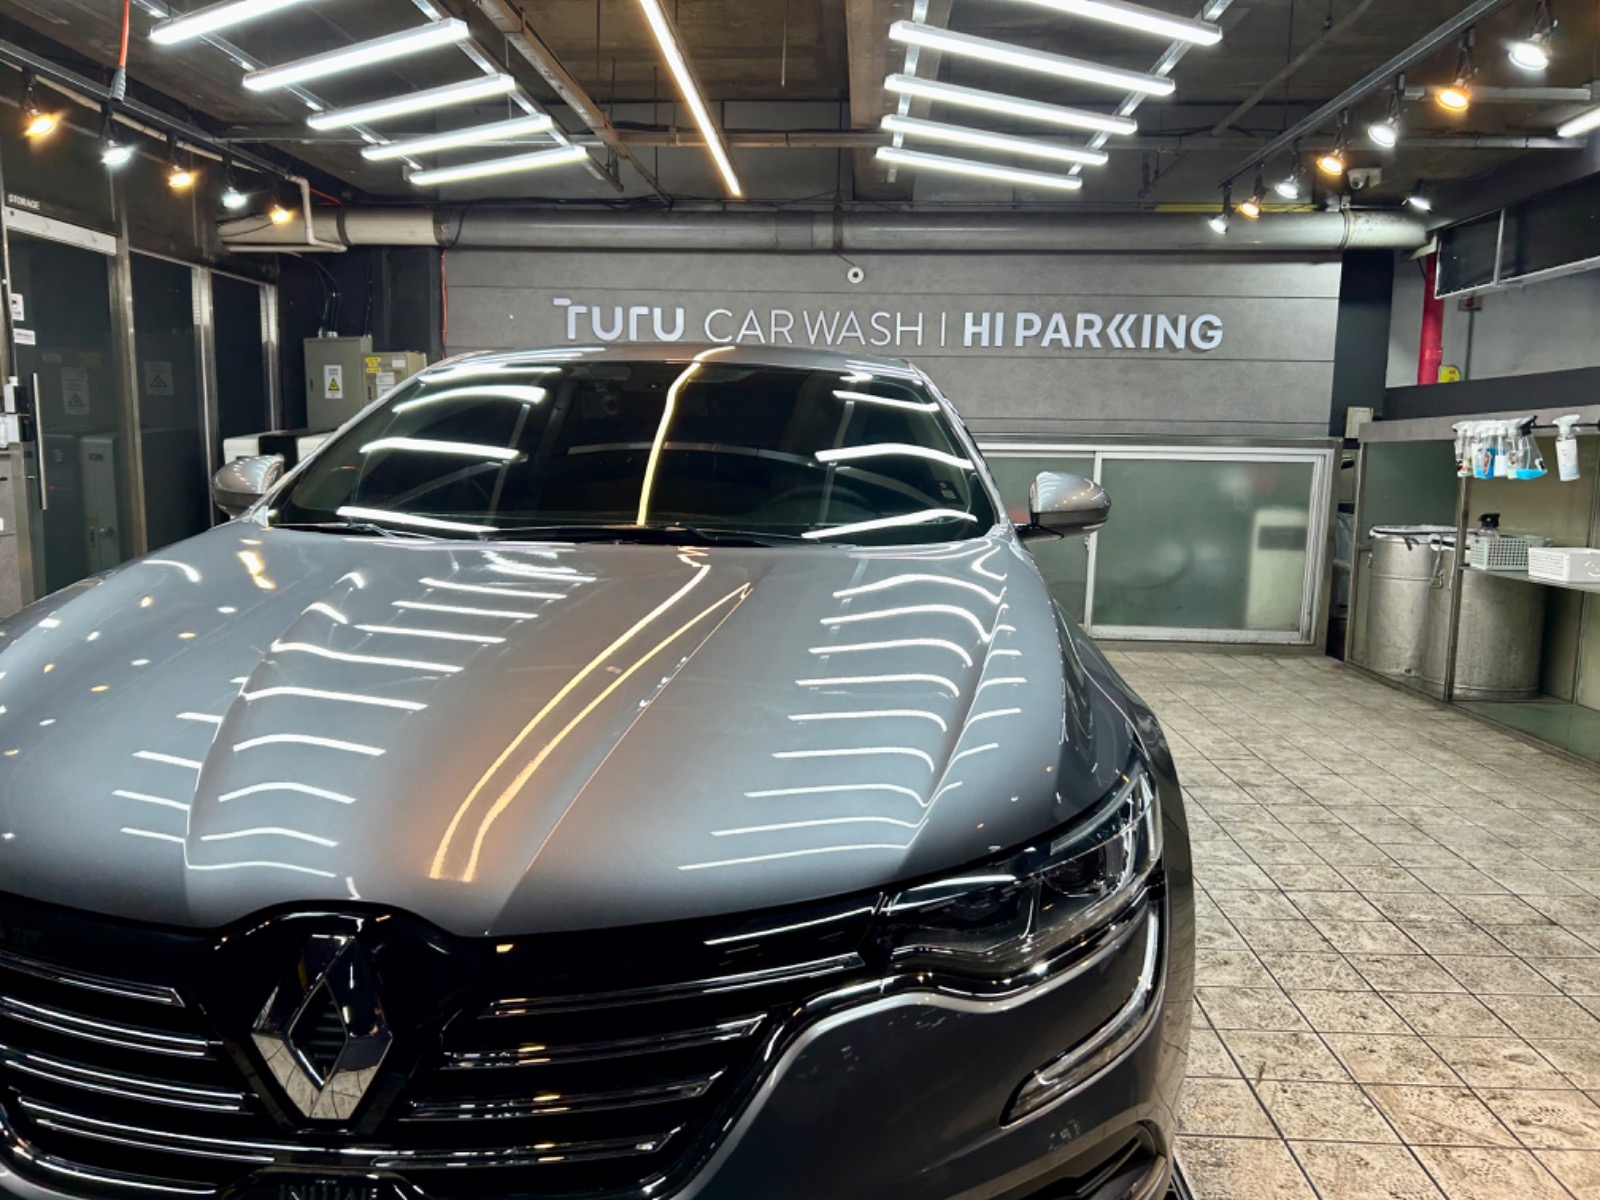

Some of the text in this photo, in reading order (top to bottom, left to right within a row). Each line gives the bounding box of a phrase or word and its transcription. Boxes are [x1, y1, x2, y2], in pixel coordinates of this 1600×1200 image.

[705, 309, 794, 344] CAR
[803, 310, 923, 346] WASH
[964, 312, 1004, 347] HI
